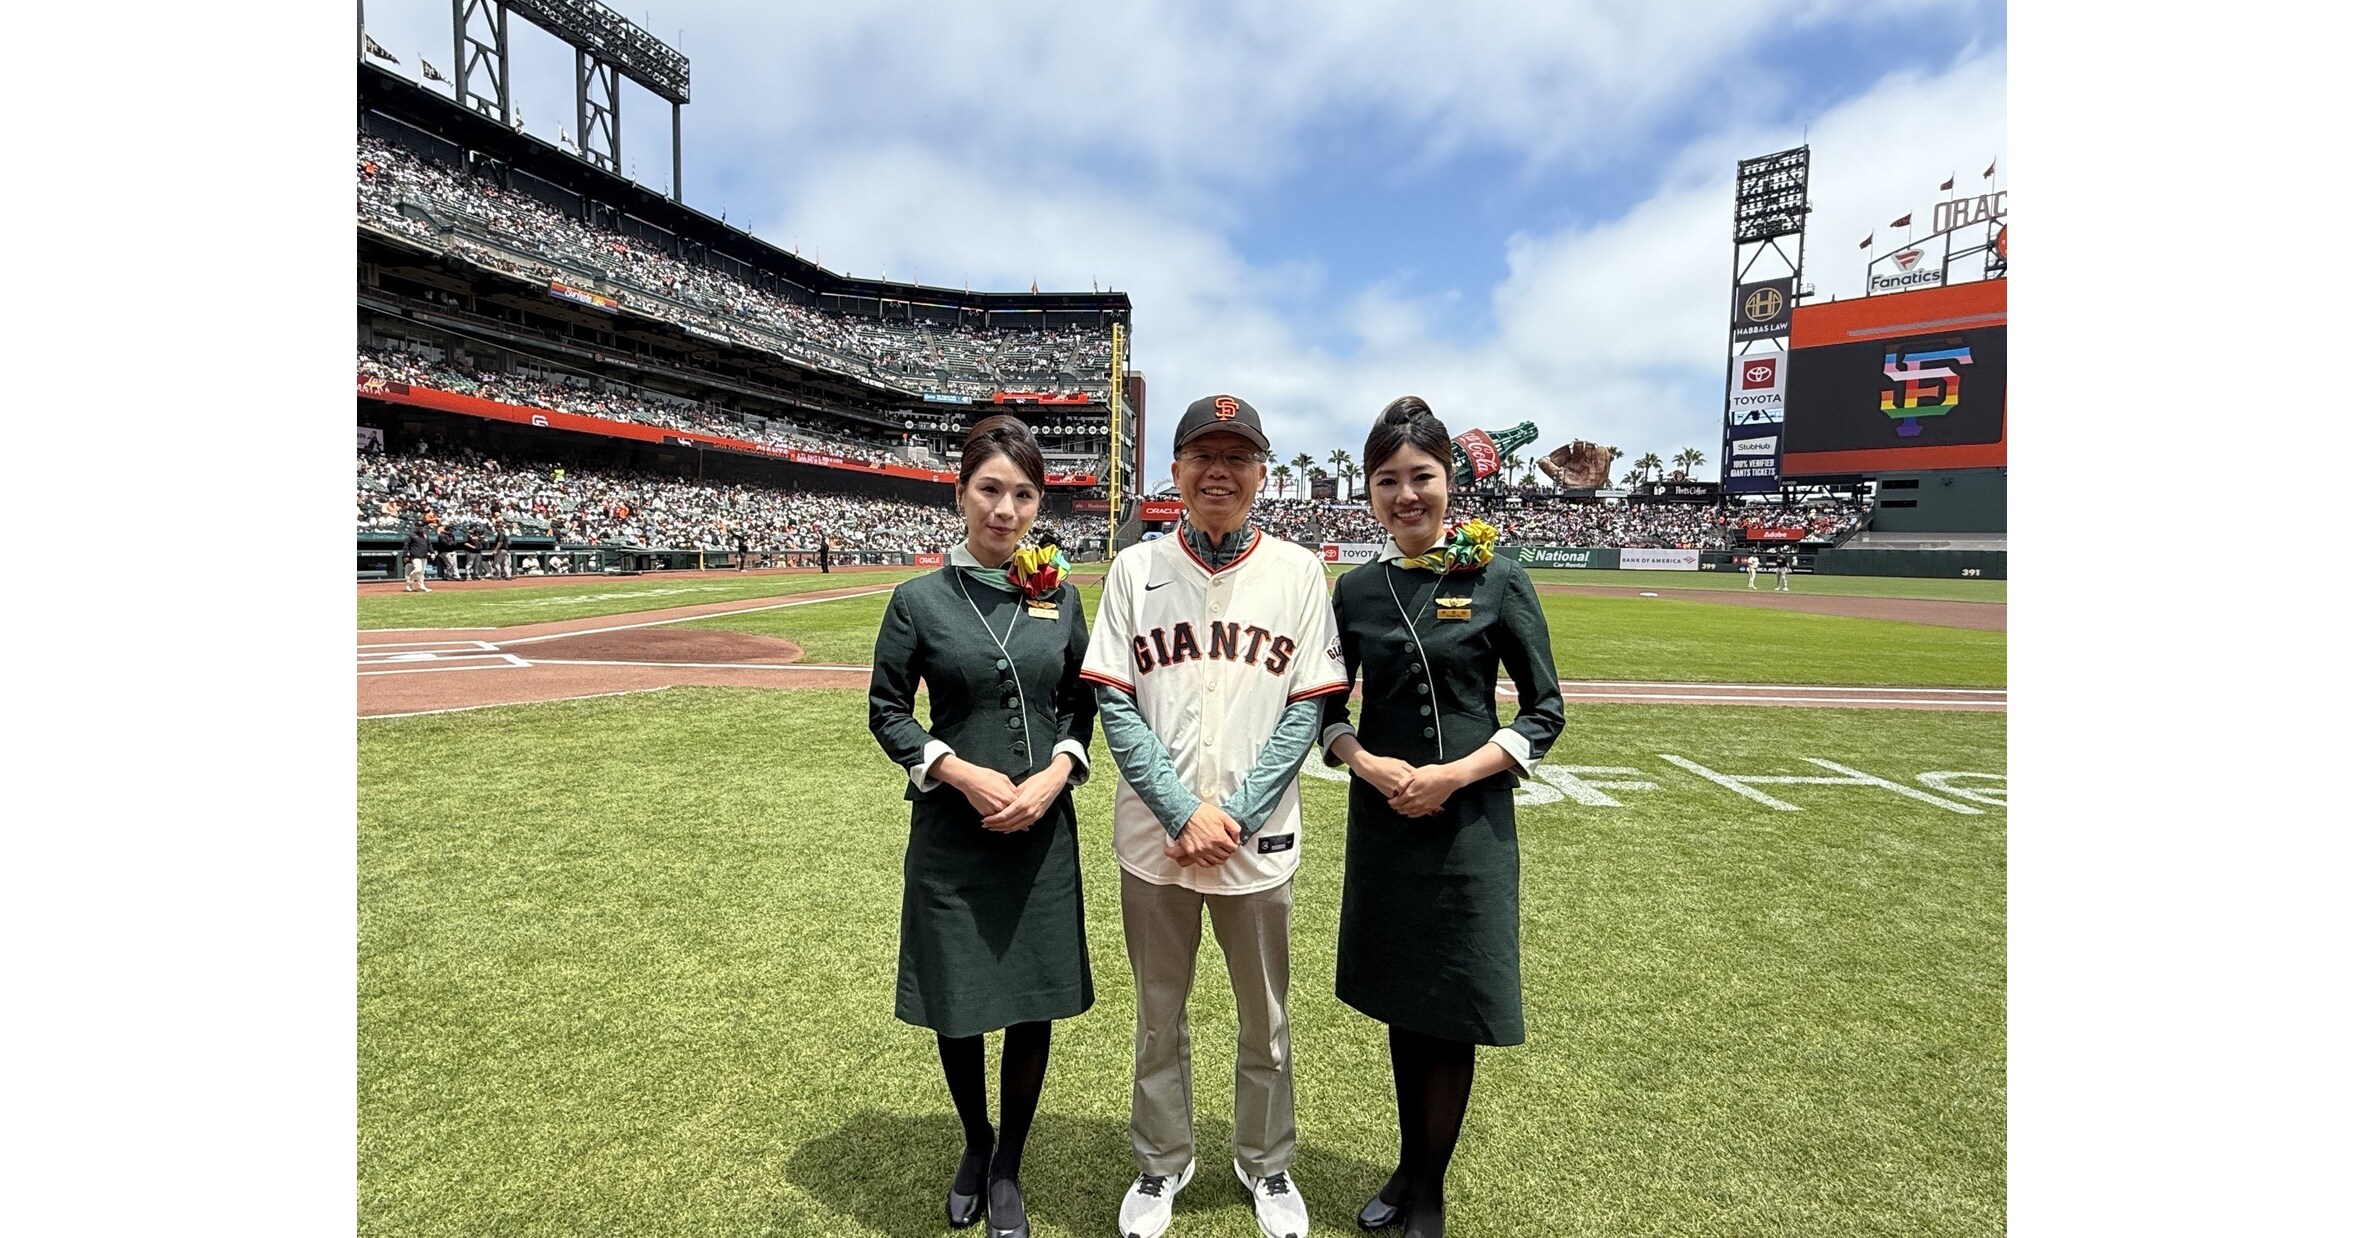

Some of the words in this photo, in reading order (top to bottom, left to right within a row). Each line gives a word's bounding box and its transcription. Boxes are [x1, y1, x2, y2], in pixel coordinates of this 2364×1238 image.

[1871, 270, 1941, 290] Fanatics
[1737, 324, 1769, 336] HABBAS
[1770, 321, 1789, 332] LAW
[1881, 338, 1974, 436] SF
[1733, 394, 1782, 406] TOYOTA
[1215, 397, 1239, 421] SF
[1738, 443, 1771, 451] StubHub
[1749, 459, 1775, 468] VERIFIED
[1730, 469, 1751, 478] GIANTS
[1751, 468, 1776, 477] TICKETS
[1145, 507, 1180, 515] ORACLE
[1342, 549, 1379, 558] TOYOTA
[1535, 549, 1590, 562] National
[1701, 562, 1716, 570] 399
[1961, 568, 1980, 576] 391
[1132, 620, 1296, 677] GIANTS
